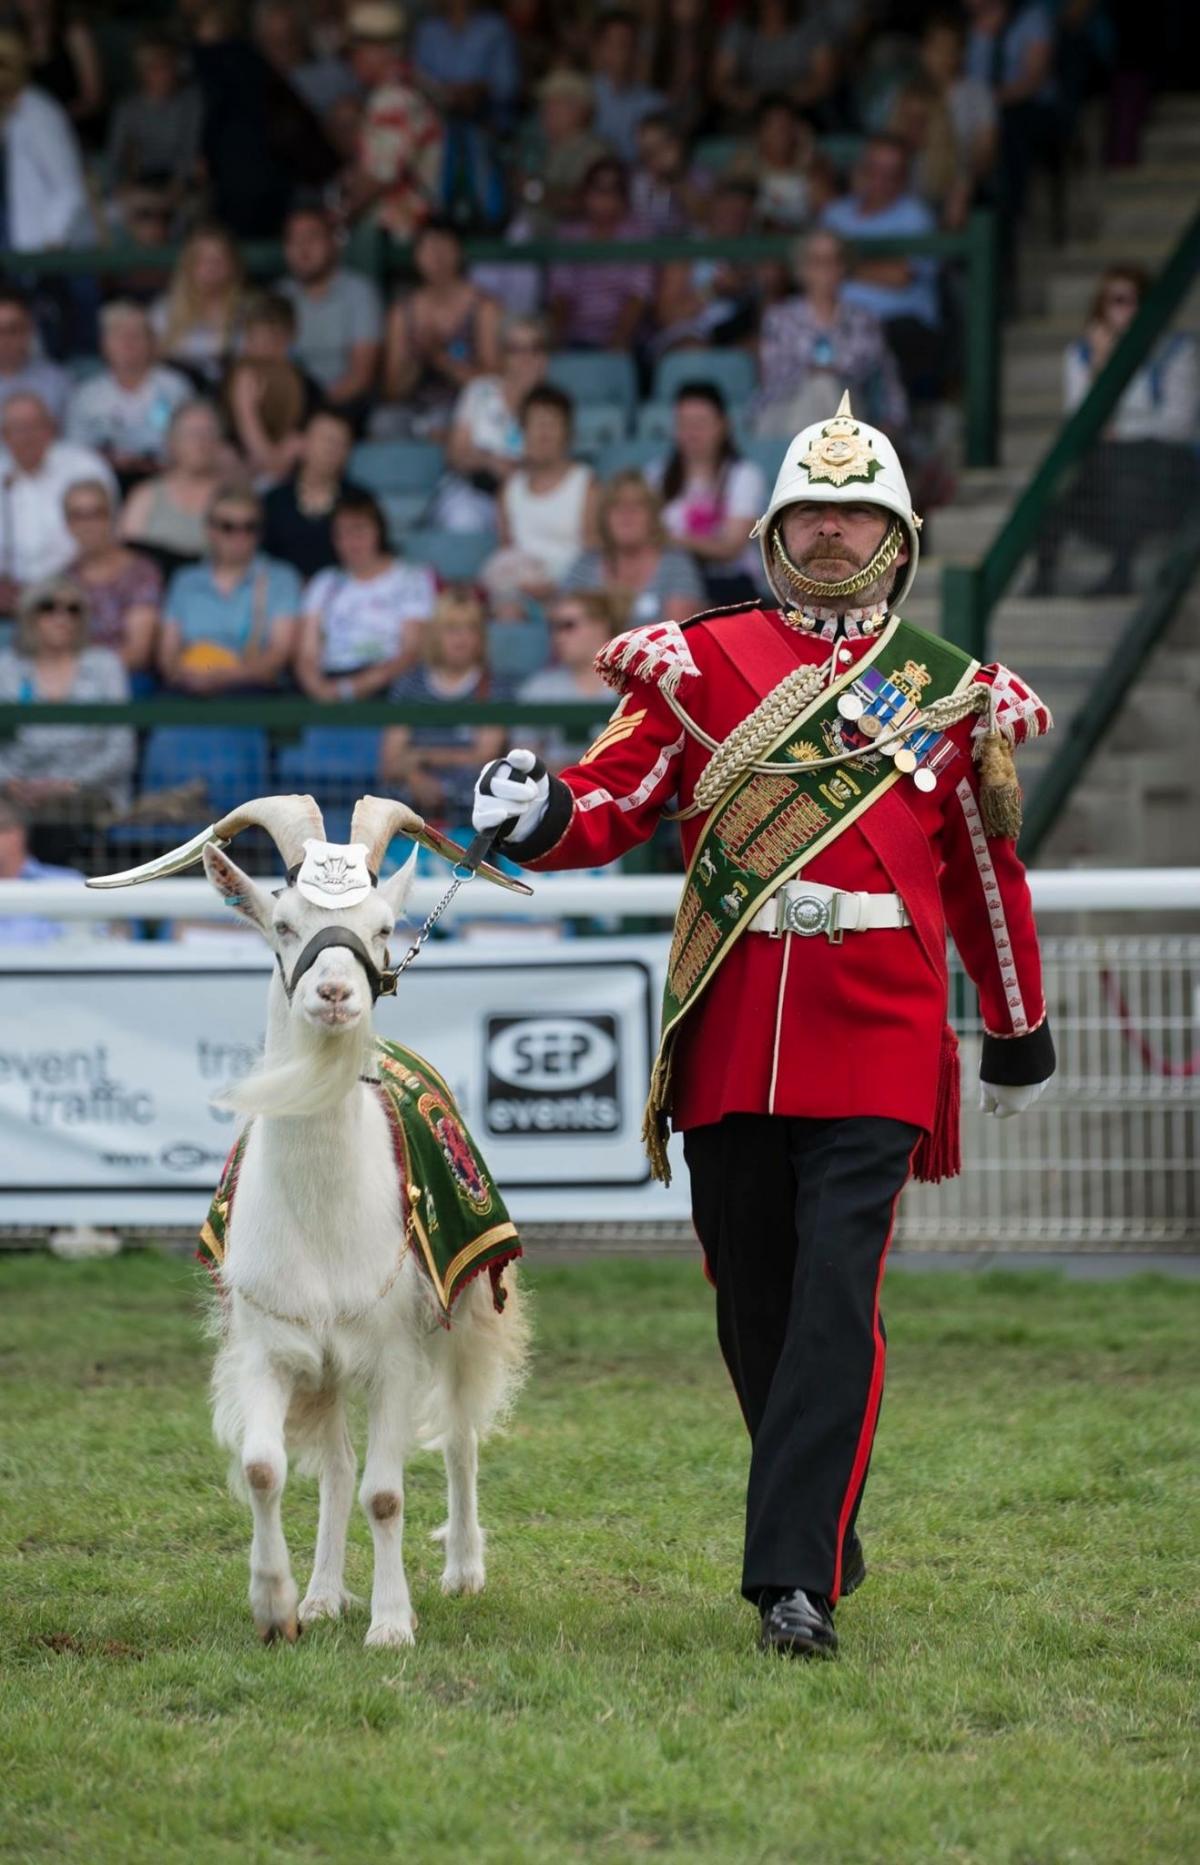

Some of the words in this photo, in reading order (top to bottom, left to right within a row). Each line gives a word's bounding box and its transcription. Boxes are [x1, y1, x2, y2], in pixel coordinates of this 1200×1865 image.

[514, 1033, 592, 1075] SEP
[30, 1082, 155, 1125] traffic
[488, 1093, 616, 1131] events
